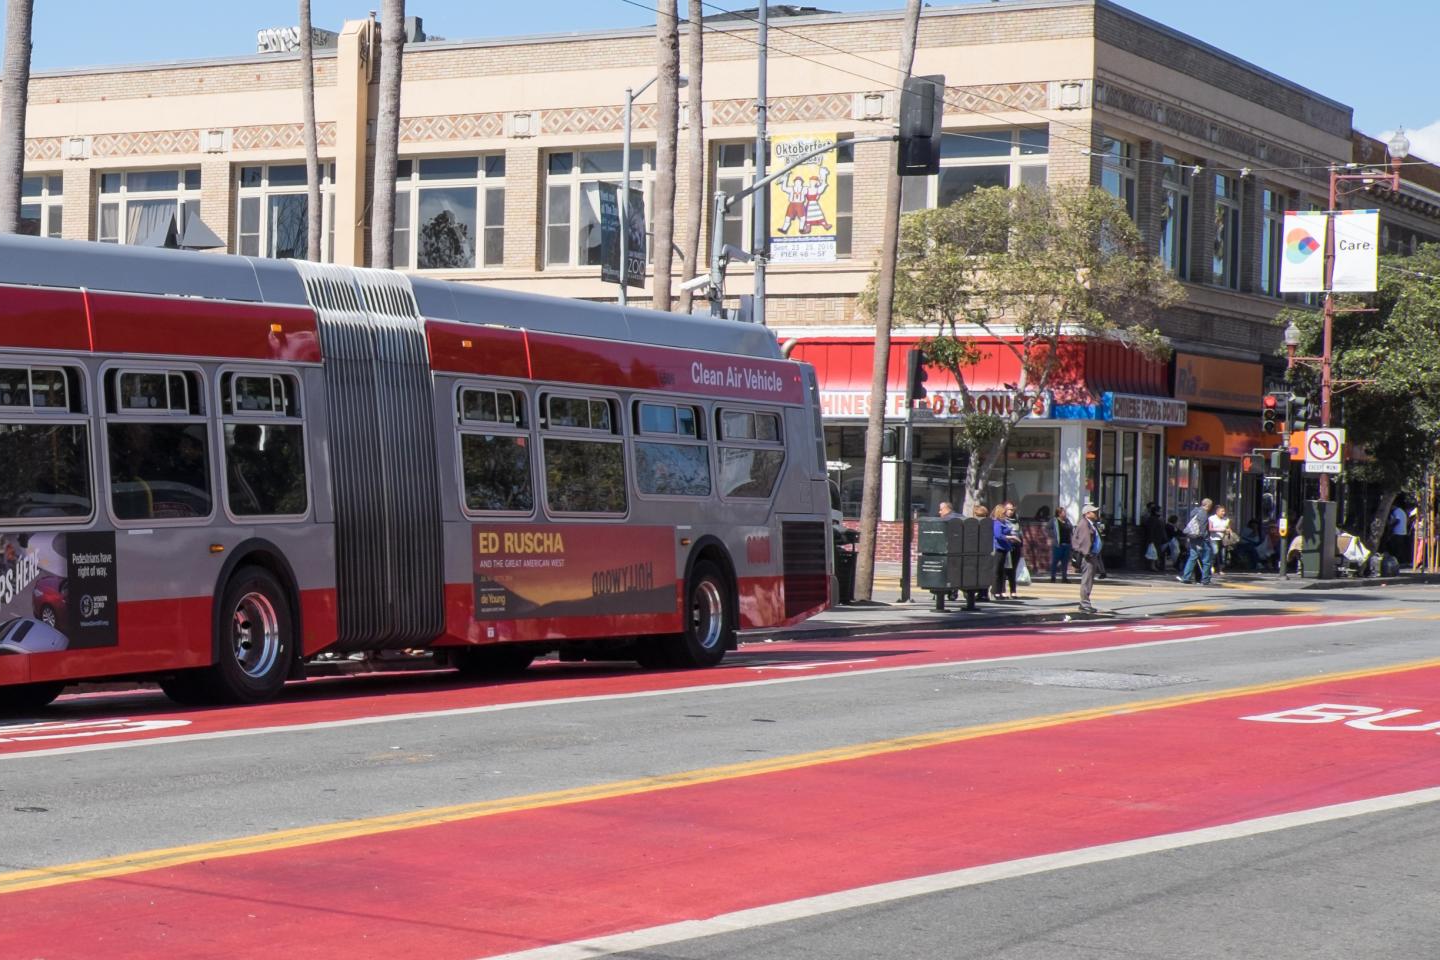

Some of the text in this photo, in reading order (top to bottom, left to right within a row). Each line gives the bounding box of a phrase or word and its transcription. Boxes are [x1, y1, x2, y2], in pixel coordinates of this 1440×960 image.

[1339, 240, 1374, 251] Care.
[627, 258, 645, 275] ZOO
[691, 361, 724, 386] Clean
[726, 366, 743, 388] Air
[743, 368, 783, 391] Vehicle
[821, 394, 888, 415] HINES
[895, 394, 945, 415] FD
[479, 532, 564, 553] ED RUSCHA
[15, 550, 41, 597] HERE
[480, 559, 564, 568] AND THE GREAT AMERICAN WEST
